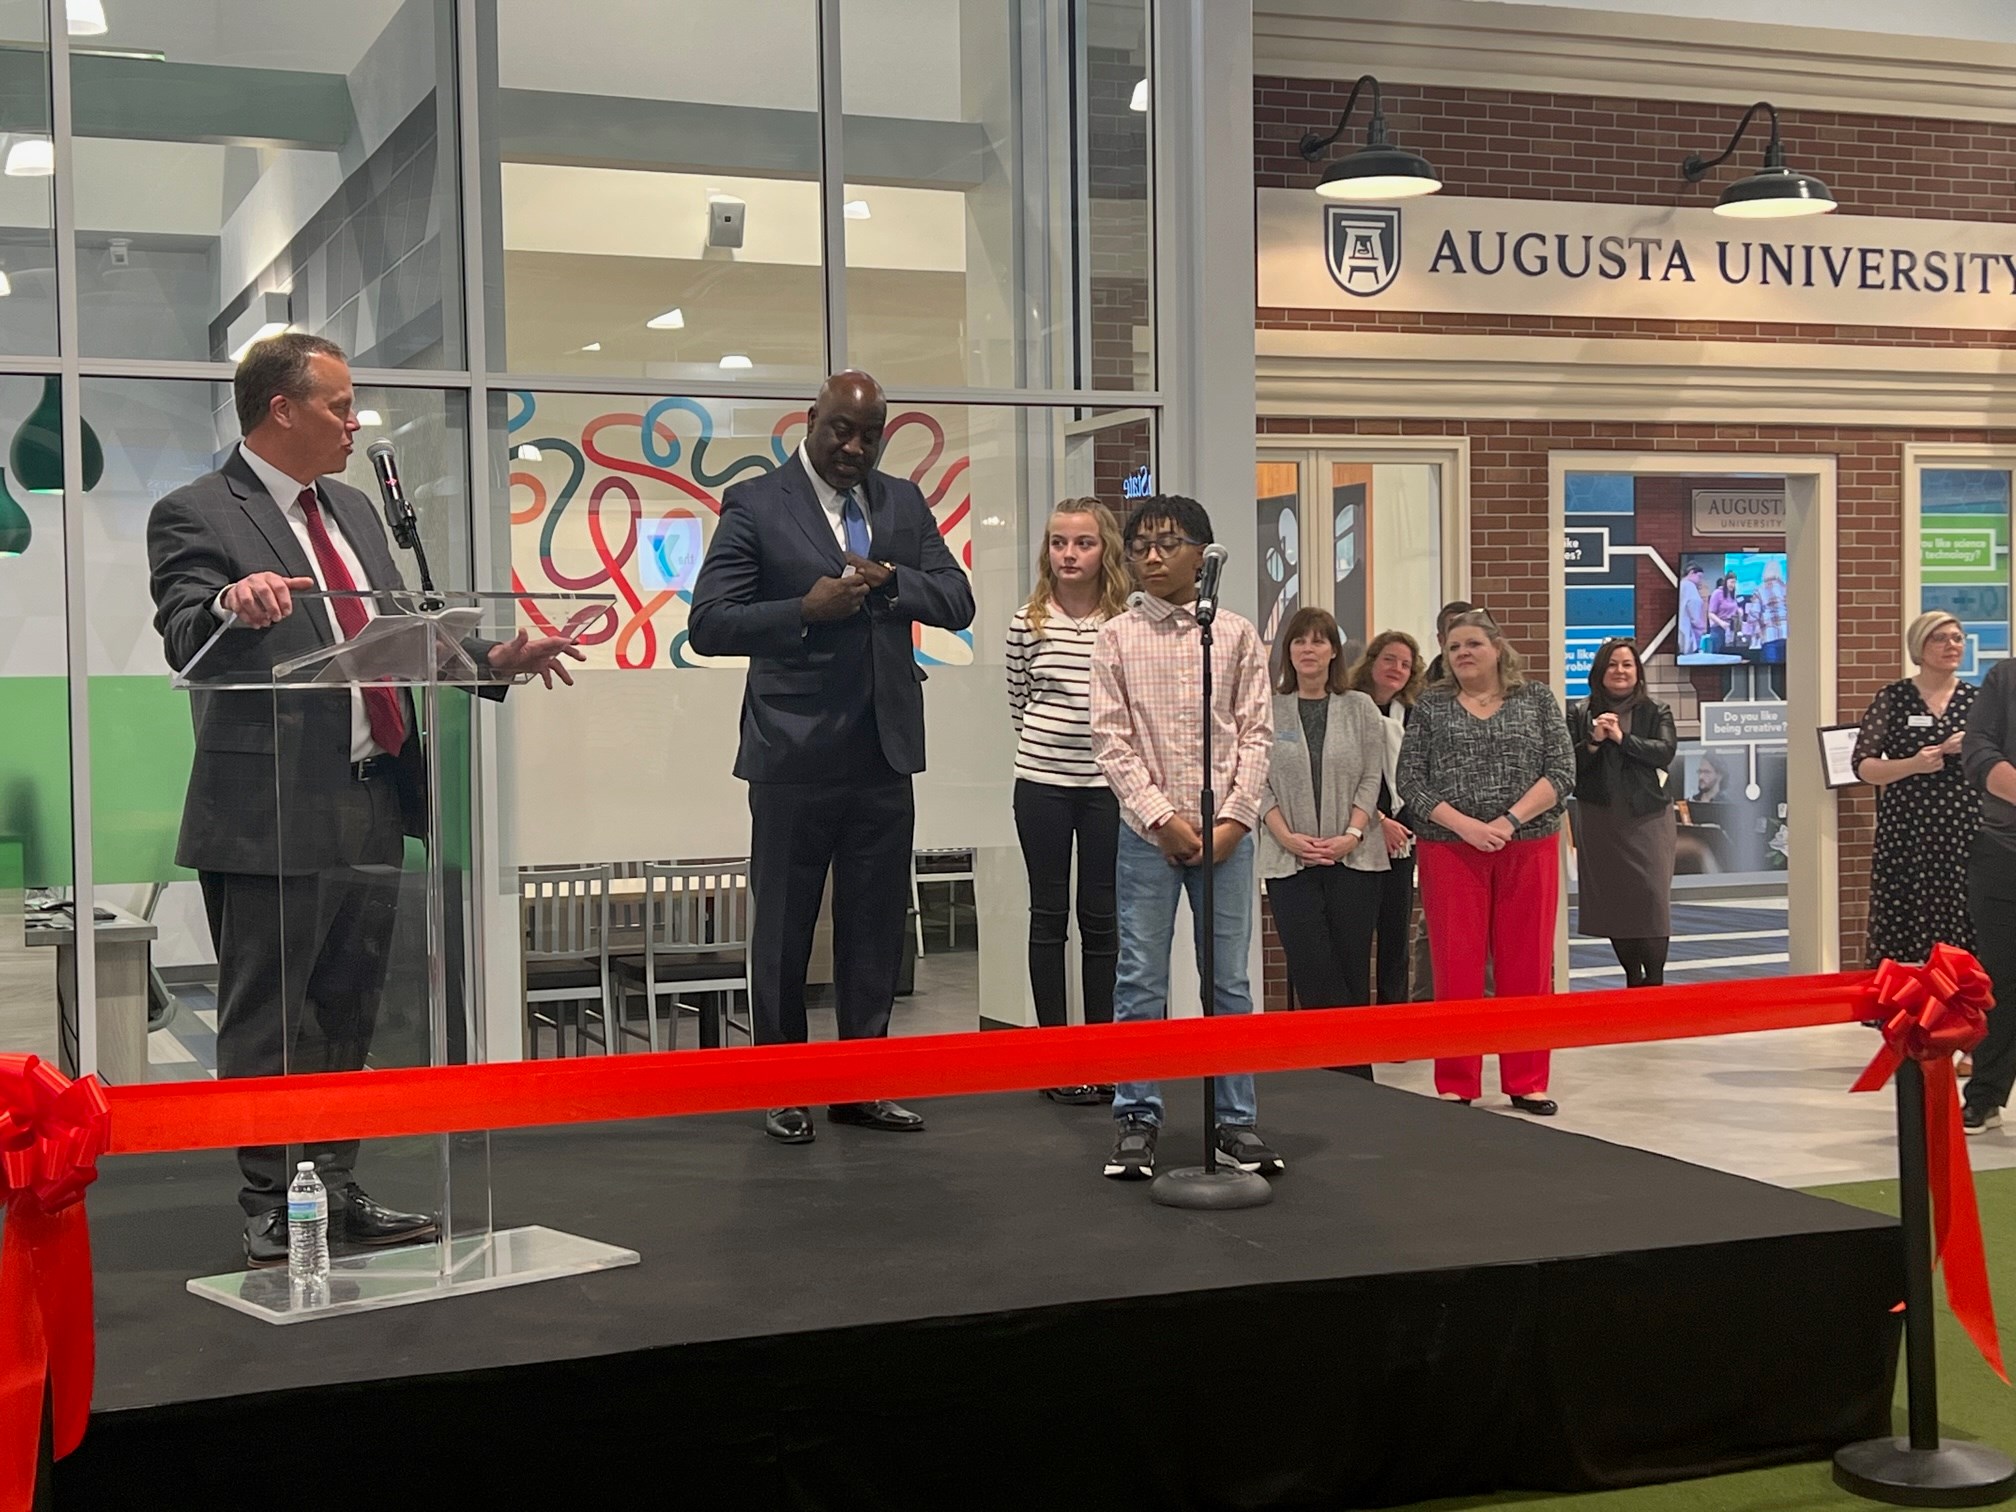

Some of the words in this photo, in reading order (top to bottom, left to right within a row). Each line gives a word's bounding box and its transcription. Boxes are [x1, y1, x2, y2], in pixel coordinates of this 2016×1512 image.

[1428, 229, 1696, 282] AUGUSTA
[1708, 498, 1786, 515] AUGUST
[1721, 519, 1782, 528] UNIVERSITY
[1564, 537, 1579, 548] ike
[1921, 540, 1933, 548] ou
[1935, 538, 1951, 548] like
[1953, 539, 1986, 548] science
[1564, 549, 1582, 560] es?
[1925, 549, 1981, 562] technology?
[1565, 661, 1592, 672] roble
[1723, 711, 1738, 722] Do
[1740, 713, 1759, 724] you
[1760, 710, 1778, 721] like
[1714, 723, 1741, 736] being
[1743, 722, 1788, 733] creative?
